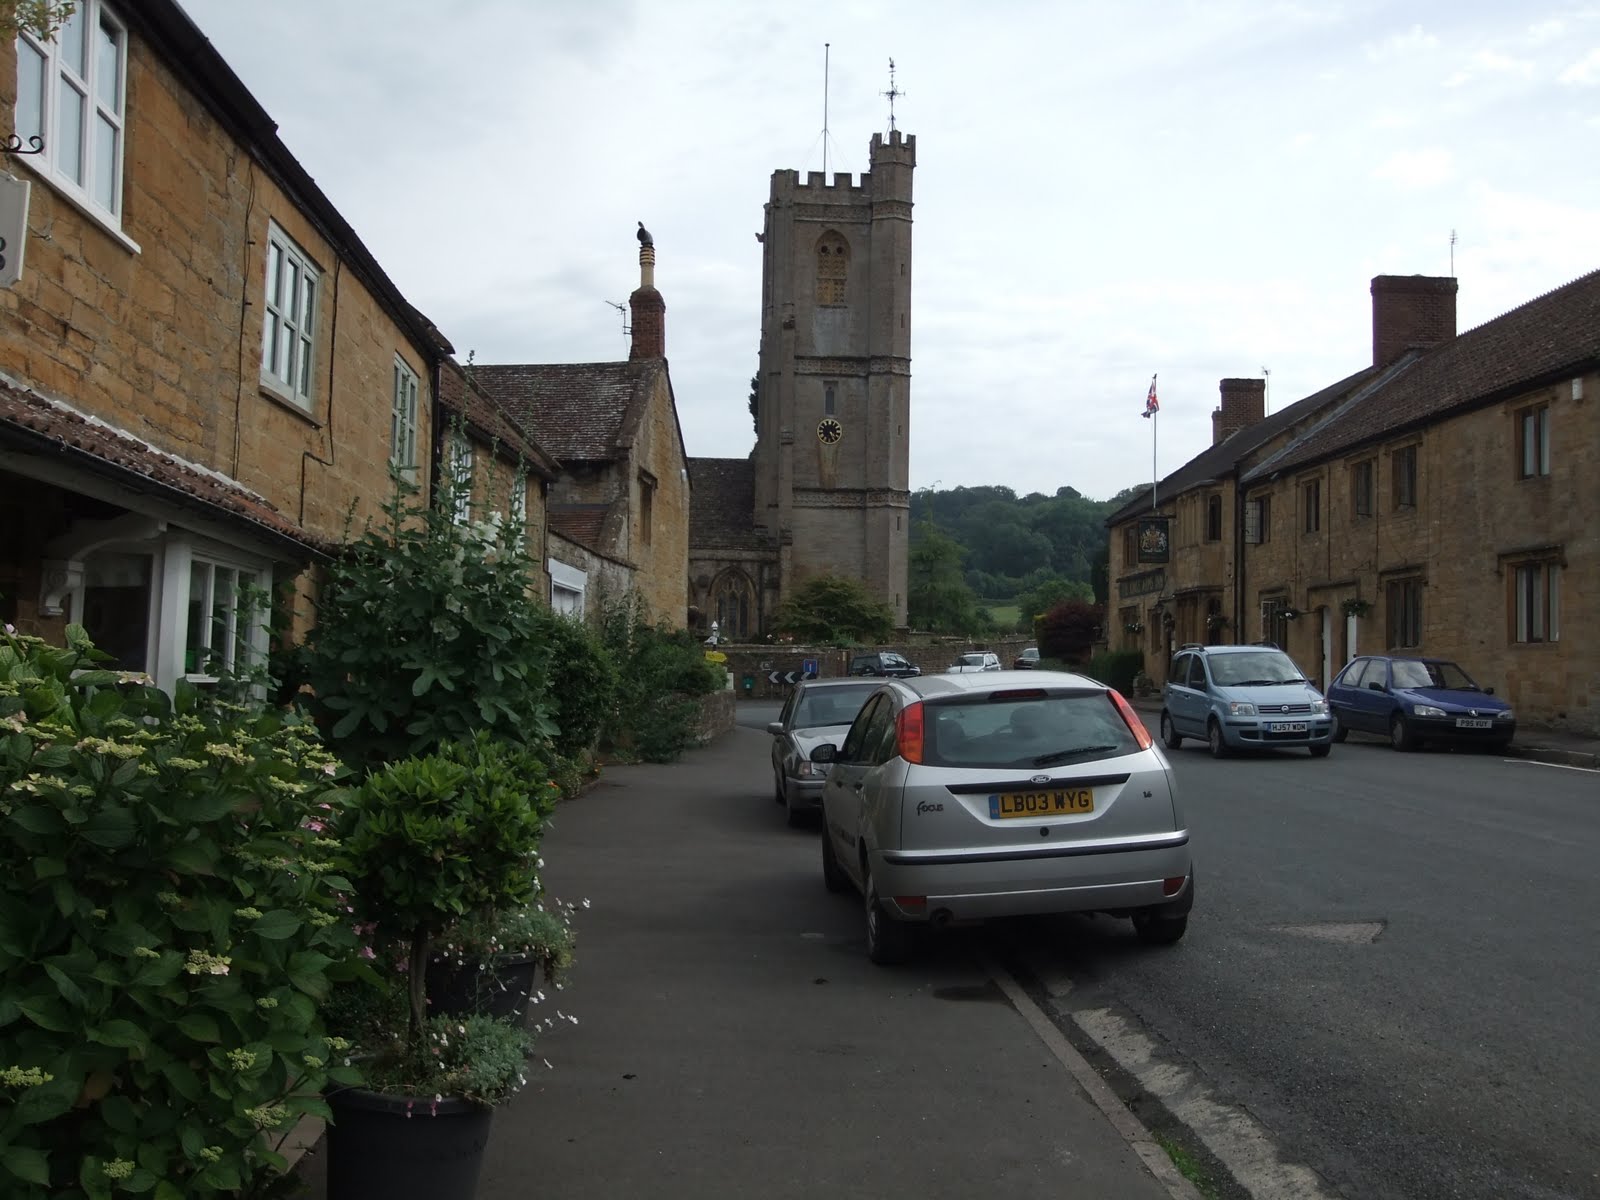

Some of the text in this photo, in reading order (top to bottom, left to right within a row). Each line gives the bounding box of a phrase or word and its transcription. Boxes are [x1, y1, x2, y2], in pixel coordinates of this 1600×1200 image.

[1271, 723, 1290, 731] HJ57
[1001, 790, 1090, 813] LB03 WYG
